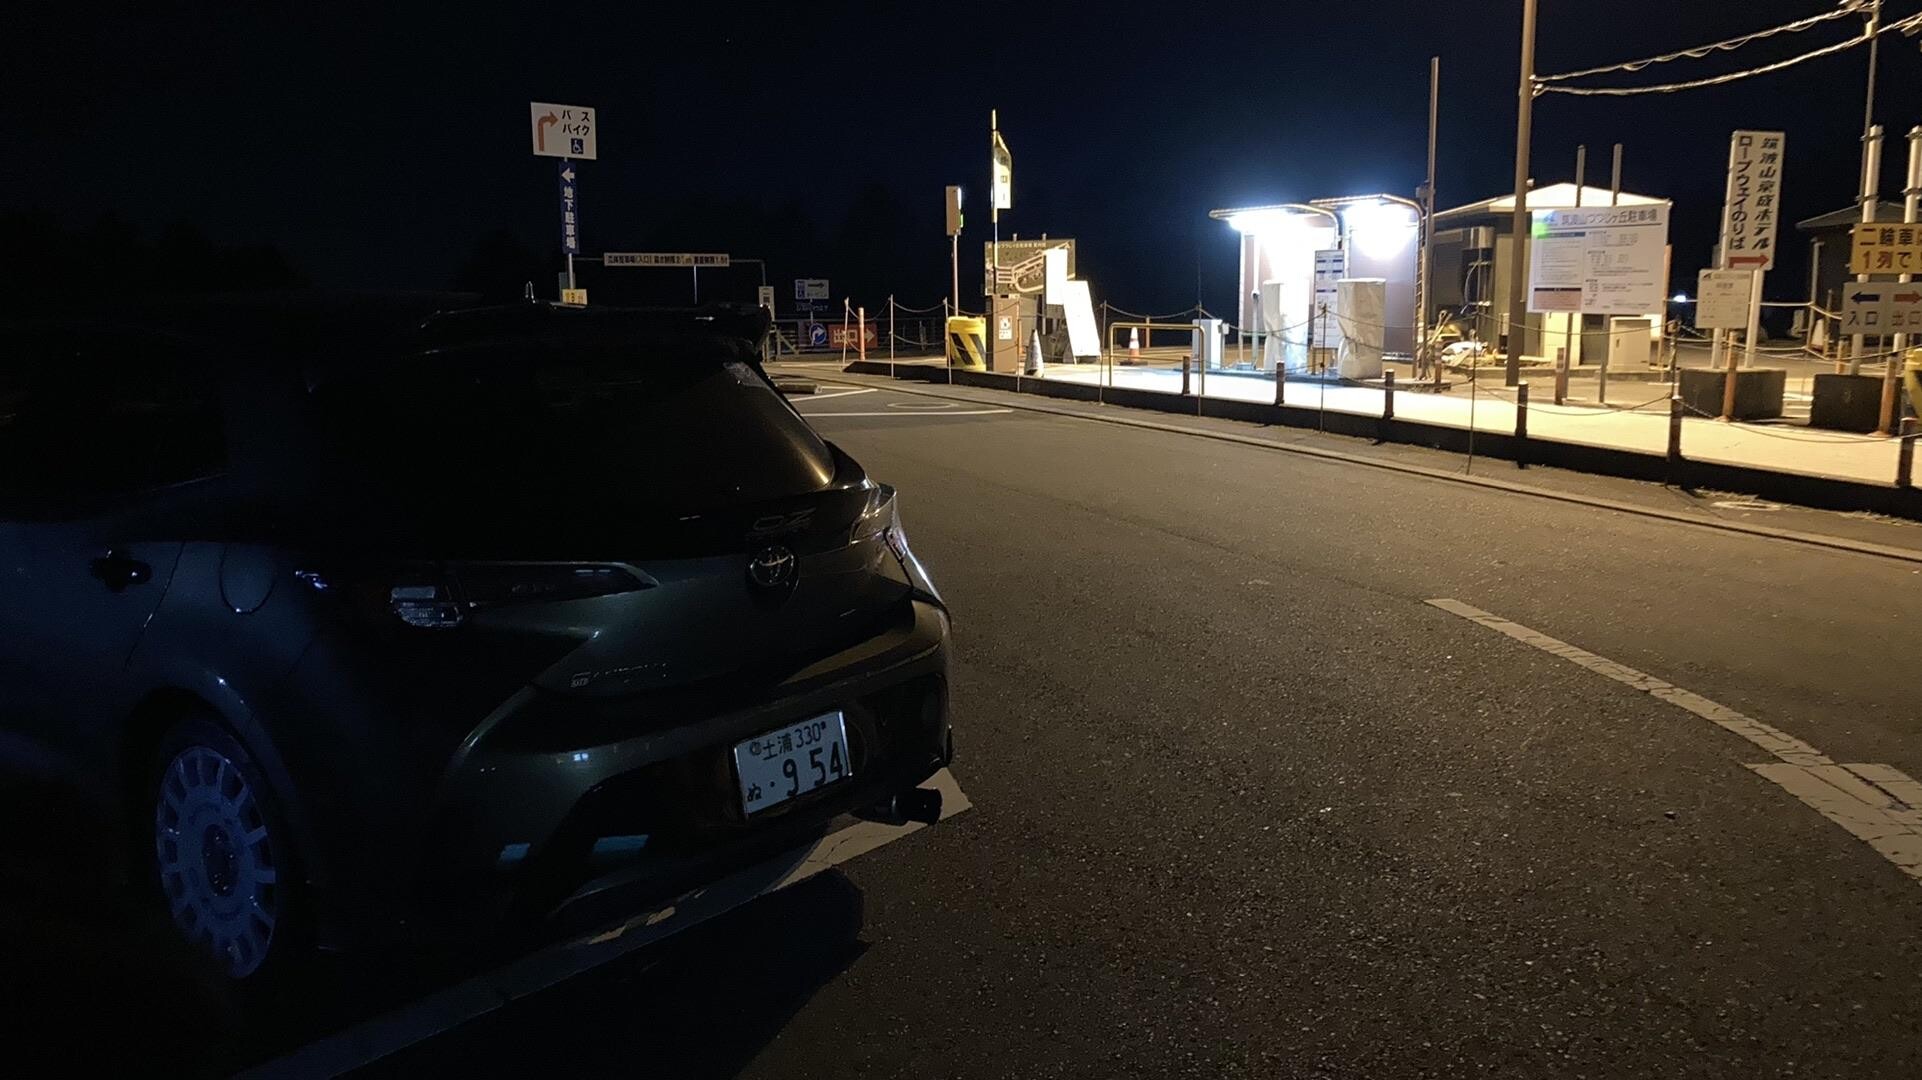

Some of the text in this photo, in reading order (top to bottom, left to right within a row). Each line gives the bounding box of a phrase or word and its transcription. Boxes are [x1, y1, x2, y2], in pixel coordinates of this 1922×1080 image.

[562, 124, 590, 136] バイク
[1847, 310, 1878, 326] 入口
[763, 723, 821, 761] 土浦 330
